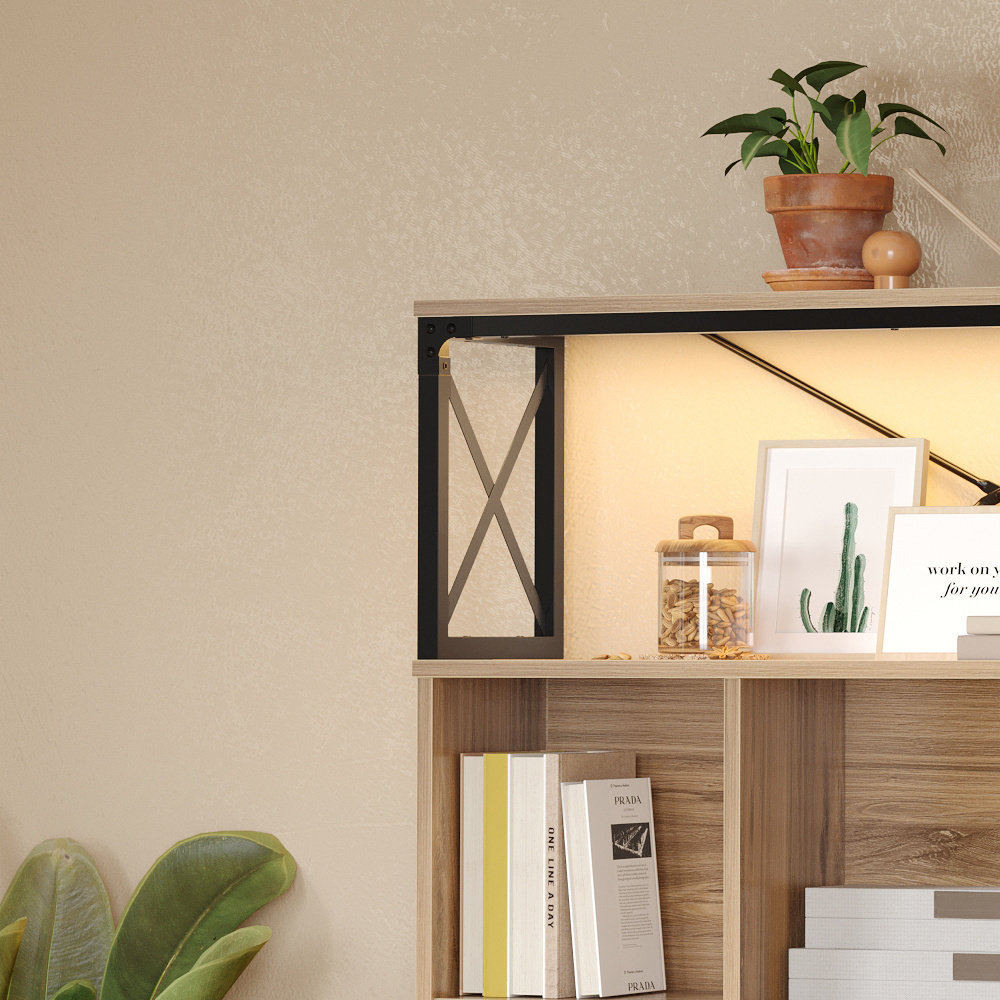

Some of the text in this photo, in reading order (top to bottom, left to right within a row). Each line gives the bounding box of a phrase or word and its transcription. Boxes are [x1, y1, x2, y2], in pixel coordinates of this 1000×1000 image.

[927, 562, 966, 575] work
[970, 566, 990, 576] on
[940, 582, 967, 598] for
[614, 796, 642, 805] PRADA
[628, 981, 655, 991] PRADA
